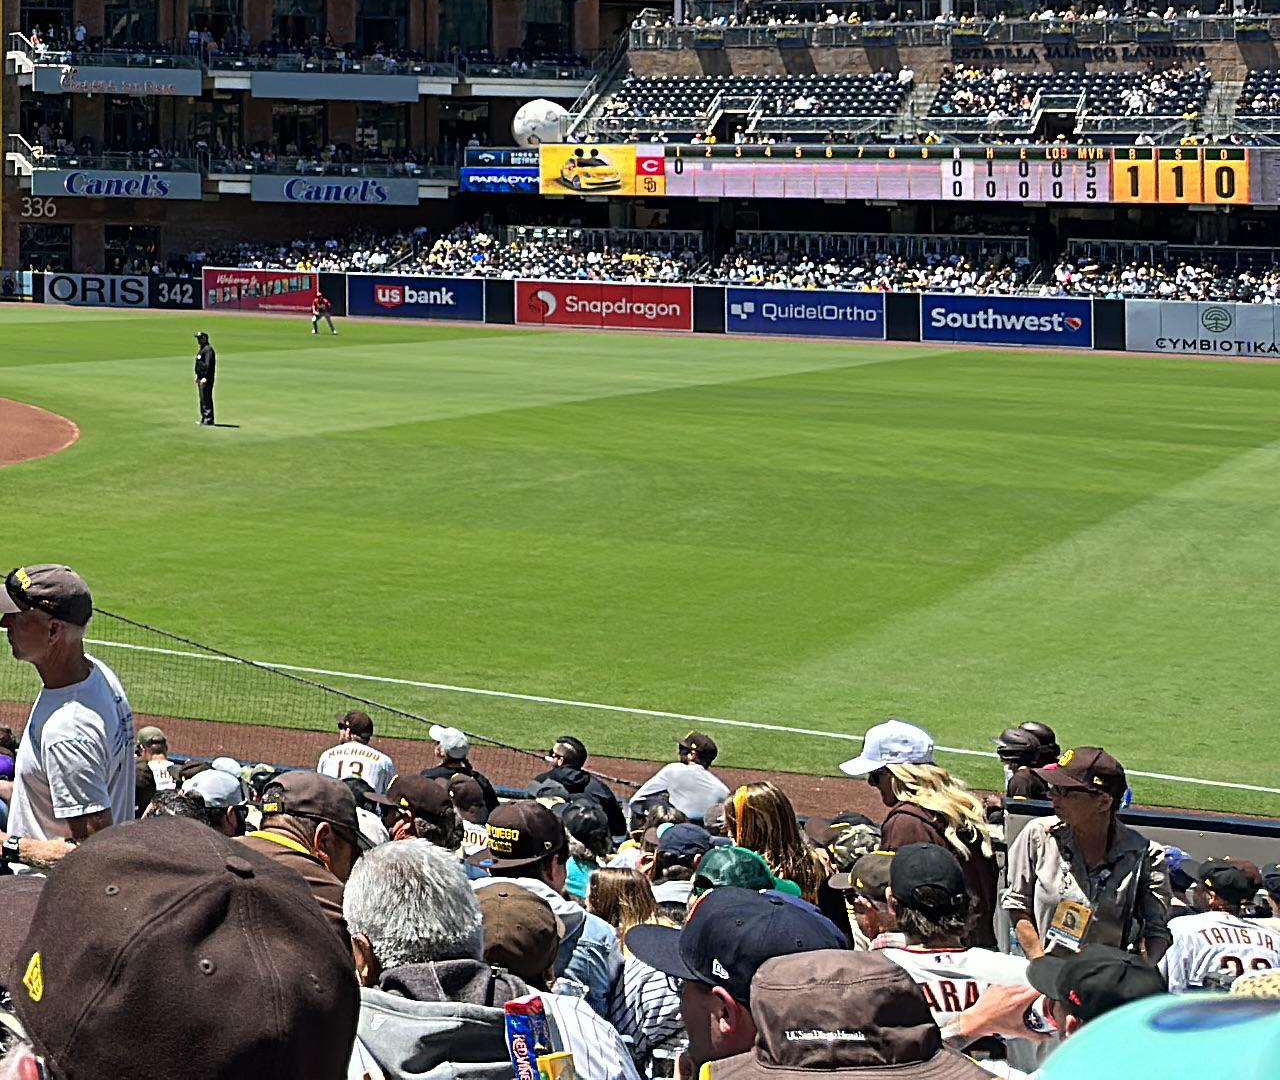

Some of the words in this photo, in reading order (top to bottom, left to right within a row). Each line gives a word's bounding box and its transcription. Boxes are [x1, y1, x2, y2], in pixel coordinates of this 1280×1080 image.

[1045, 149, 1067, 159] LOB
[1078, 149, 1104, 159] MVR
[65, 171, 171, 198] Canel's
[674, 158, 683, 175] 0
[952, 160, 962, 177] 0
[1019, 160, 1029, 177] 0
[1052, 160, 1062, 177] 0
[1086, 161, 1096, 177] 5
[1127, 166, 1139, 197] 1
[1171, 166, 1184, 198] 1
[1216, 166, 1235, 198] 0
[283, 177, 388, 204] Canel's
[952, 181, 962, 197] 0
[986, 181, 996, 198] 0
[1019, 181, 1029, 198] 0
[1052, 181, 1063, 198] 0
[1086, 182, 1097, 199] 5
[21, 197, 57, 217] 336
[48, 275, 145, 305] ORIS
[158, 282, 193, 304] 342
[377, 288, 400, 303] us
[405, 286, 453, 305] bank
[565, 295, 681, 320] Snapdragon
[762, 303, 877, 322] QuidelOrtho
[931, 308, 1063, 332] Southwest
[1156, 336, 1280, 354] CYMBIOTIKA
[328, 748, 381, 762] MACHADO
[1198, 928, 1251, 946] TATIS
